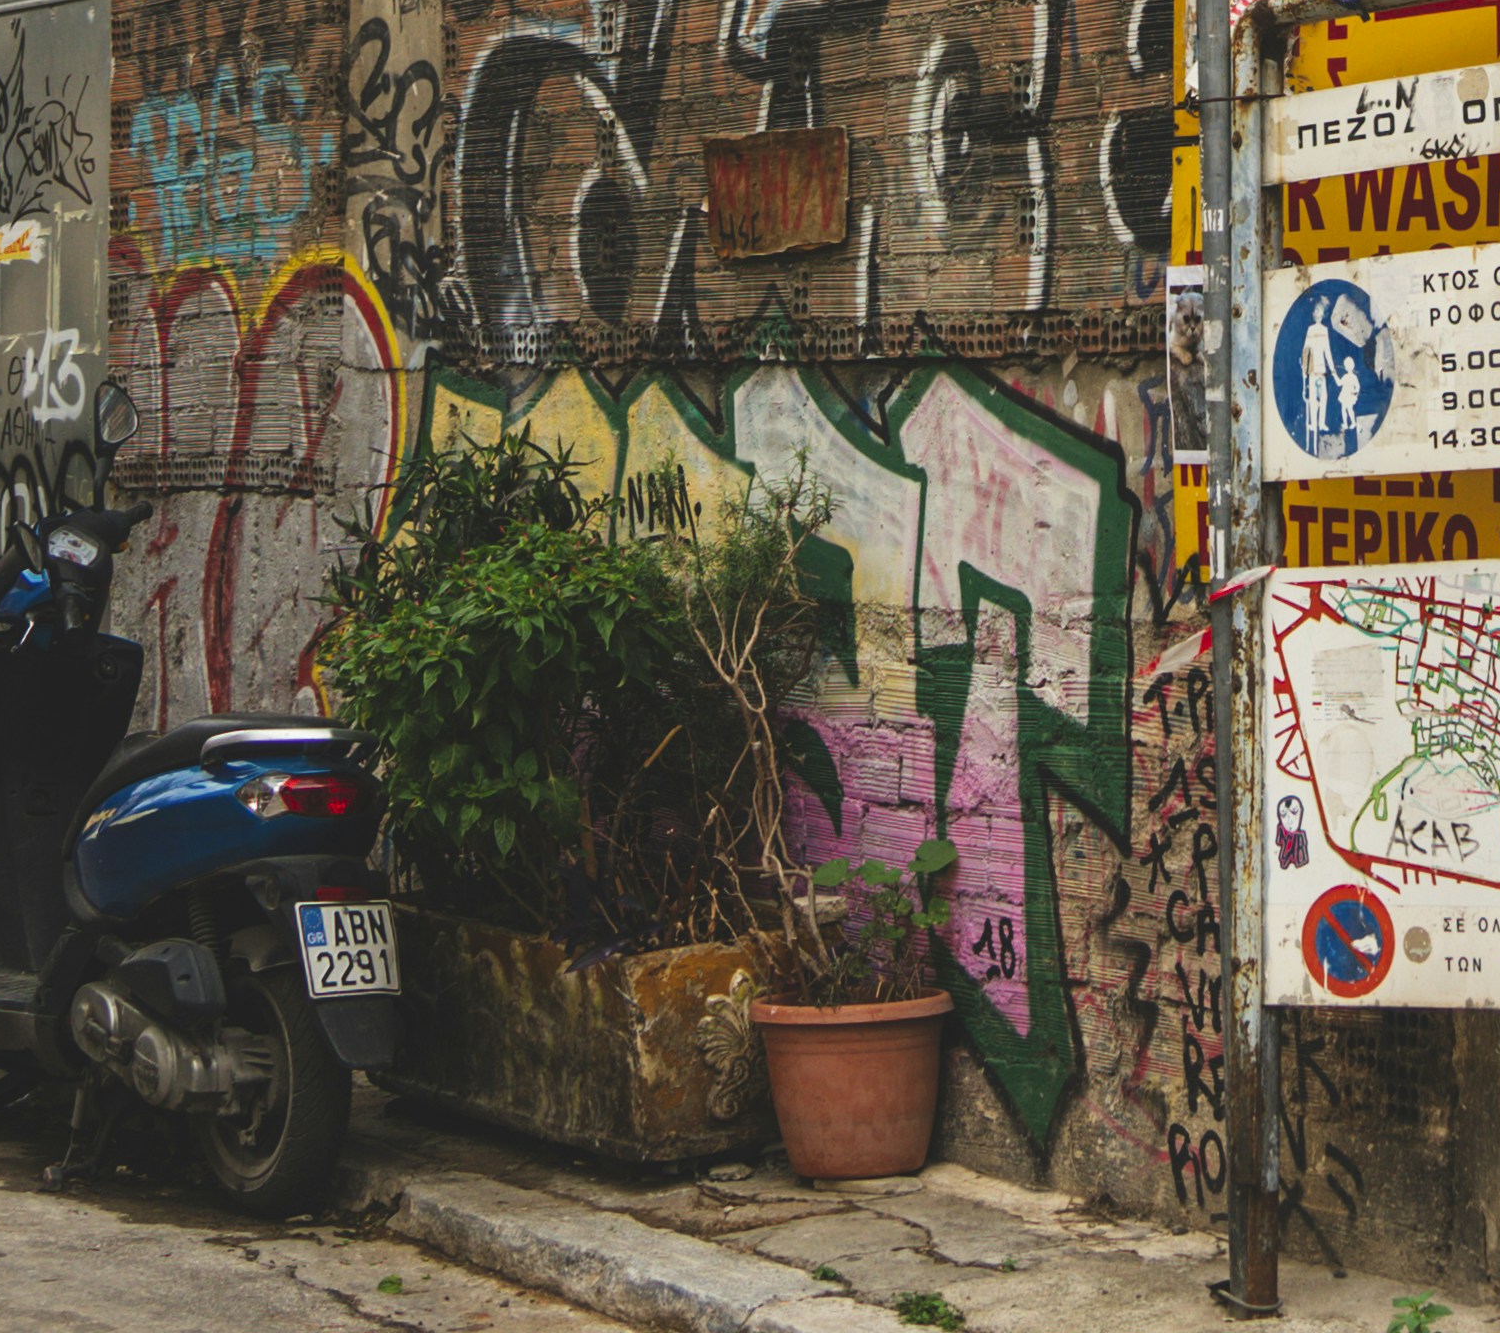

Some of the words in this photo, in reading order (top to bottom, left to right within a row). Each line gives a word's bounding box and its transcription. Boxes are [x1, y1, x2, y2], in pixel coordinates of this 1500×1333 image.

[1386, 811, 1481, 865] ACAB
[306, 932, 326, 945] GR
[334, 910, 388, 947] ABN
[1442, 917, 1467, 935] ΣΕ
[316, 948, 392, 989] 2291
[1444, 955, 1483, 974] ΤΩΝ
